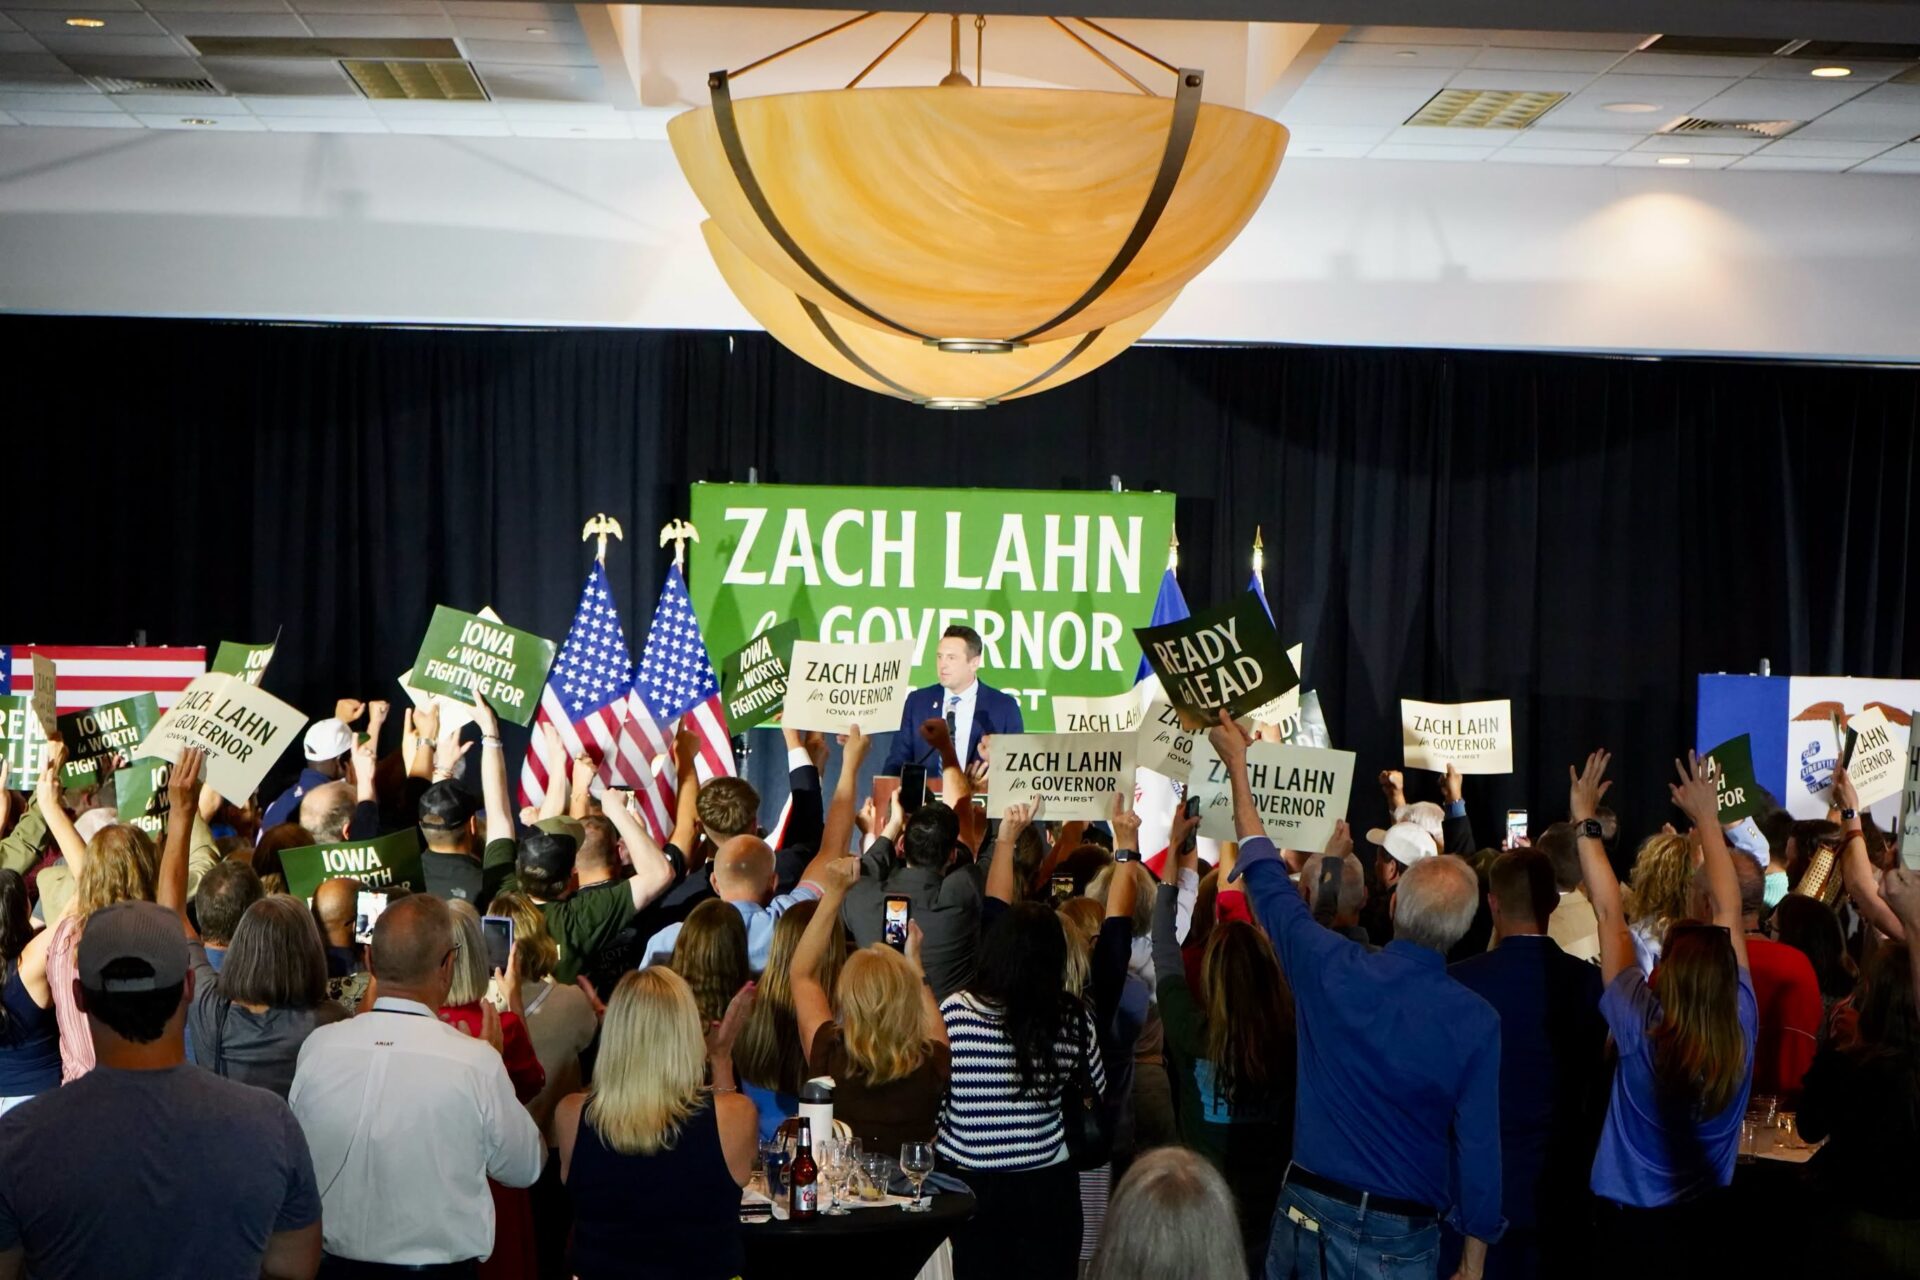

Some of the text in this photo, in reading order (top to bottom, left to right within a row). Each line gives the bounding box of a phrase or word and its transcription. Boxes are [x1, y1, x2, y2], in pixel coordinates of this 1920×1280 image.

[722, 508, 1144, 594] ZACH LAHN
[459, 620, 515, 659] IOWA
[740, 636, 773, 673] IOWA
[1153, 616, 1242, 675] READY
[460, 646, 516, 681] WORTH
[743, 658, 785, 689] WORTH
[805, 661, 857, 684] ZACH
[863, 659, 901, 684] LAHN
[424, 659, 525, 708] FIGHTING FOR
[806, 686, 894, 705] for GOVERNOR
[1190, 656, 1264, 709] LEAD
[730, 678, 785, 719] FIGHTING
[826, 708, 878, 716] IOWA FIRST
[76, 707, 128, 737] IOWA
[176, 691, 278, 747] ZACH LAHN
[1067, 714, 1110, 732] ZACH
[1414, 716, 1499, 735] ZACH LAHN
[88, 727, 139, 753] WORTH
[175, 714, 253, 764] GOVERNOR
[1153, 731, 1170, 744] for
[1433, 738, 1496, 751] GOVERNOR
[1857, 725, 1890, 755] LAHN
[1005, 751, 1122, 772] ZACH LAHN
[1850, 748, 1895, 779] GOVERNOR
[1009, 776, 1116, 792] for GOVERNOR
[1274, 765, 1335, 795] LAHN
[1210, 792, 1326, 818] for OVERNOR
[1717, 787, 1746, 811] FOR
[1268, 818, 1302, 829] FIRST
[321, 846, 383, 873] IOWA
